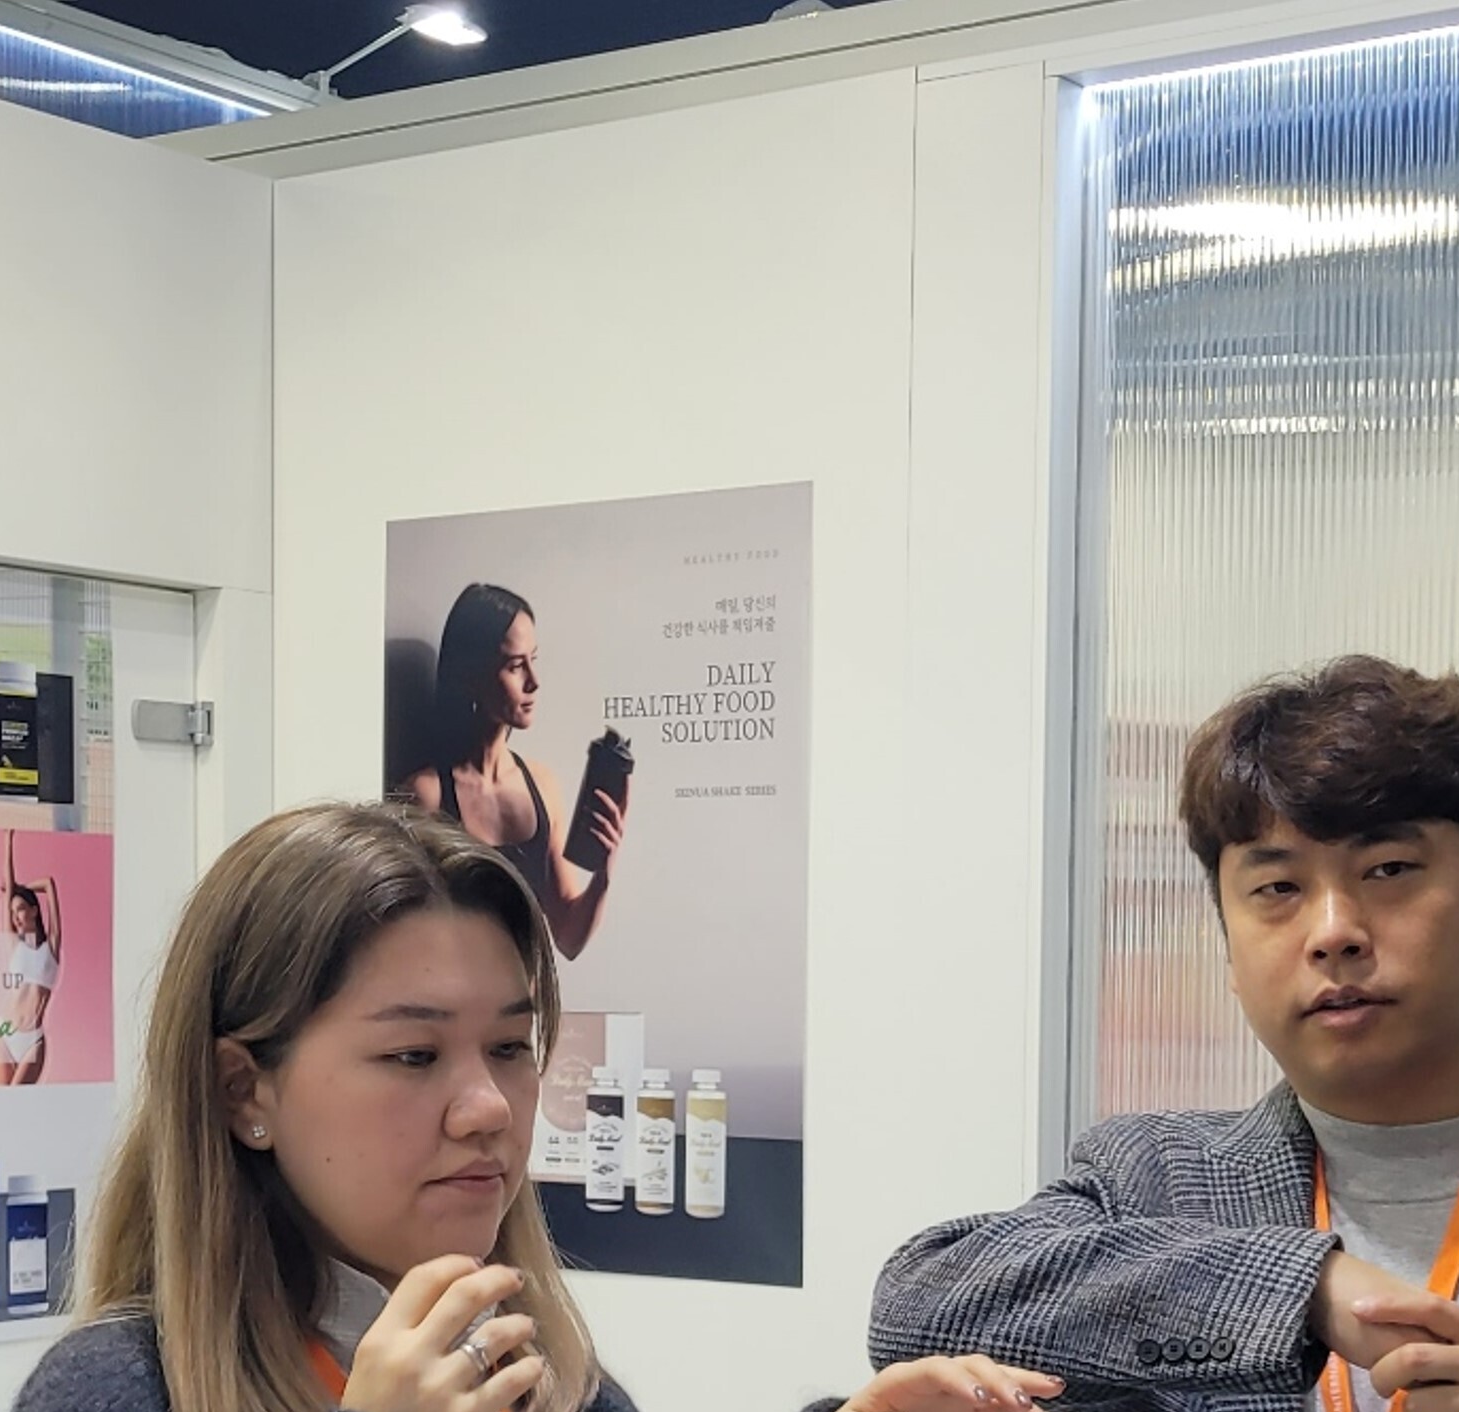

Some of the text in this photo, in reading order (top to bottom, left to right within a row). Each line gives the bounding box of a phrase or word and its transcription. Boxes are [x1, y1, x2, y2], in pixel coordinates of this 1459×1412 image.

[706, 661, 776, 688] DAILY
[603, 690, 776, 720] HEALTHY FOOD
[661, 718, 776, 744] SOLUTION
[2, 973, 24, 990] UP
